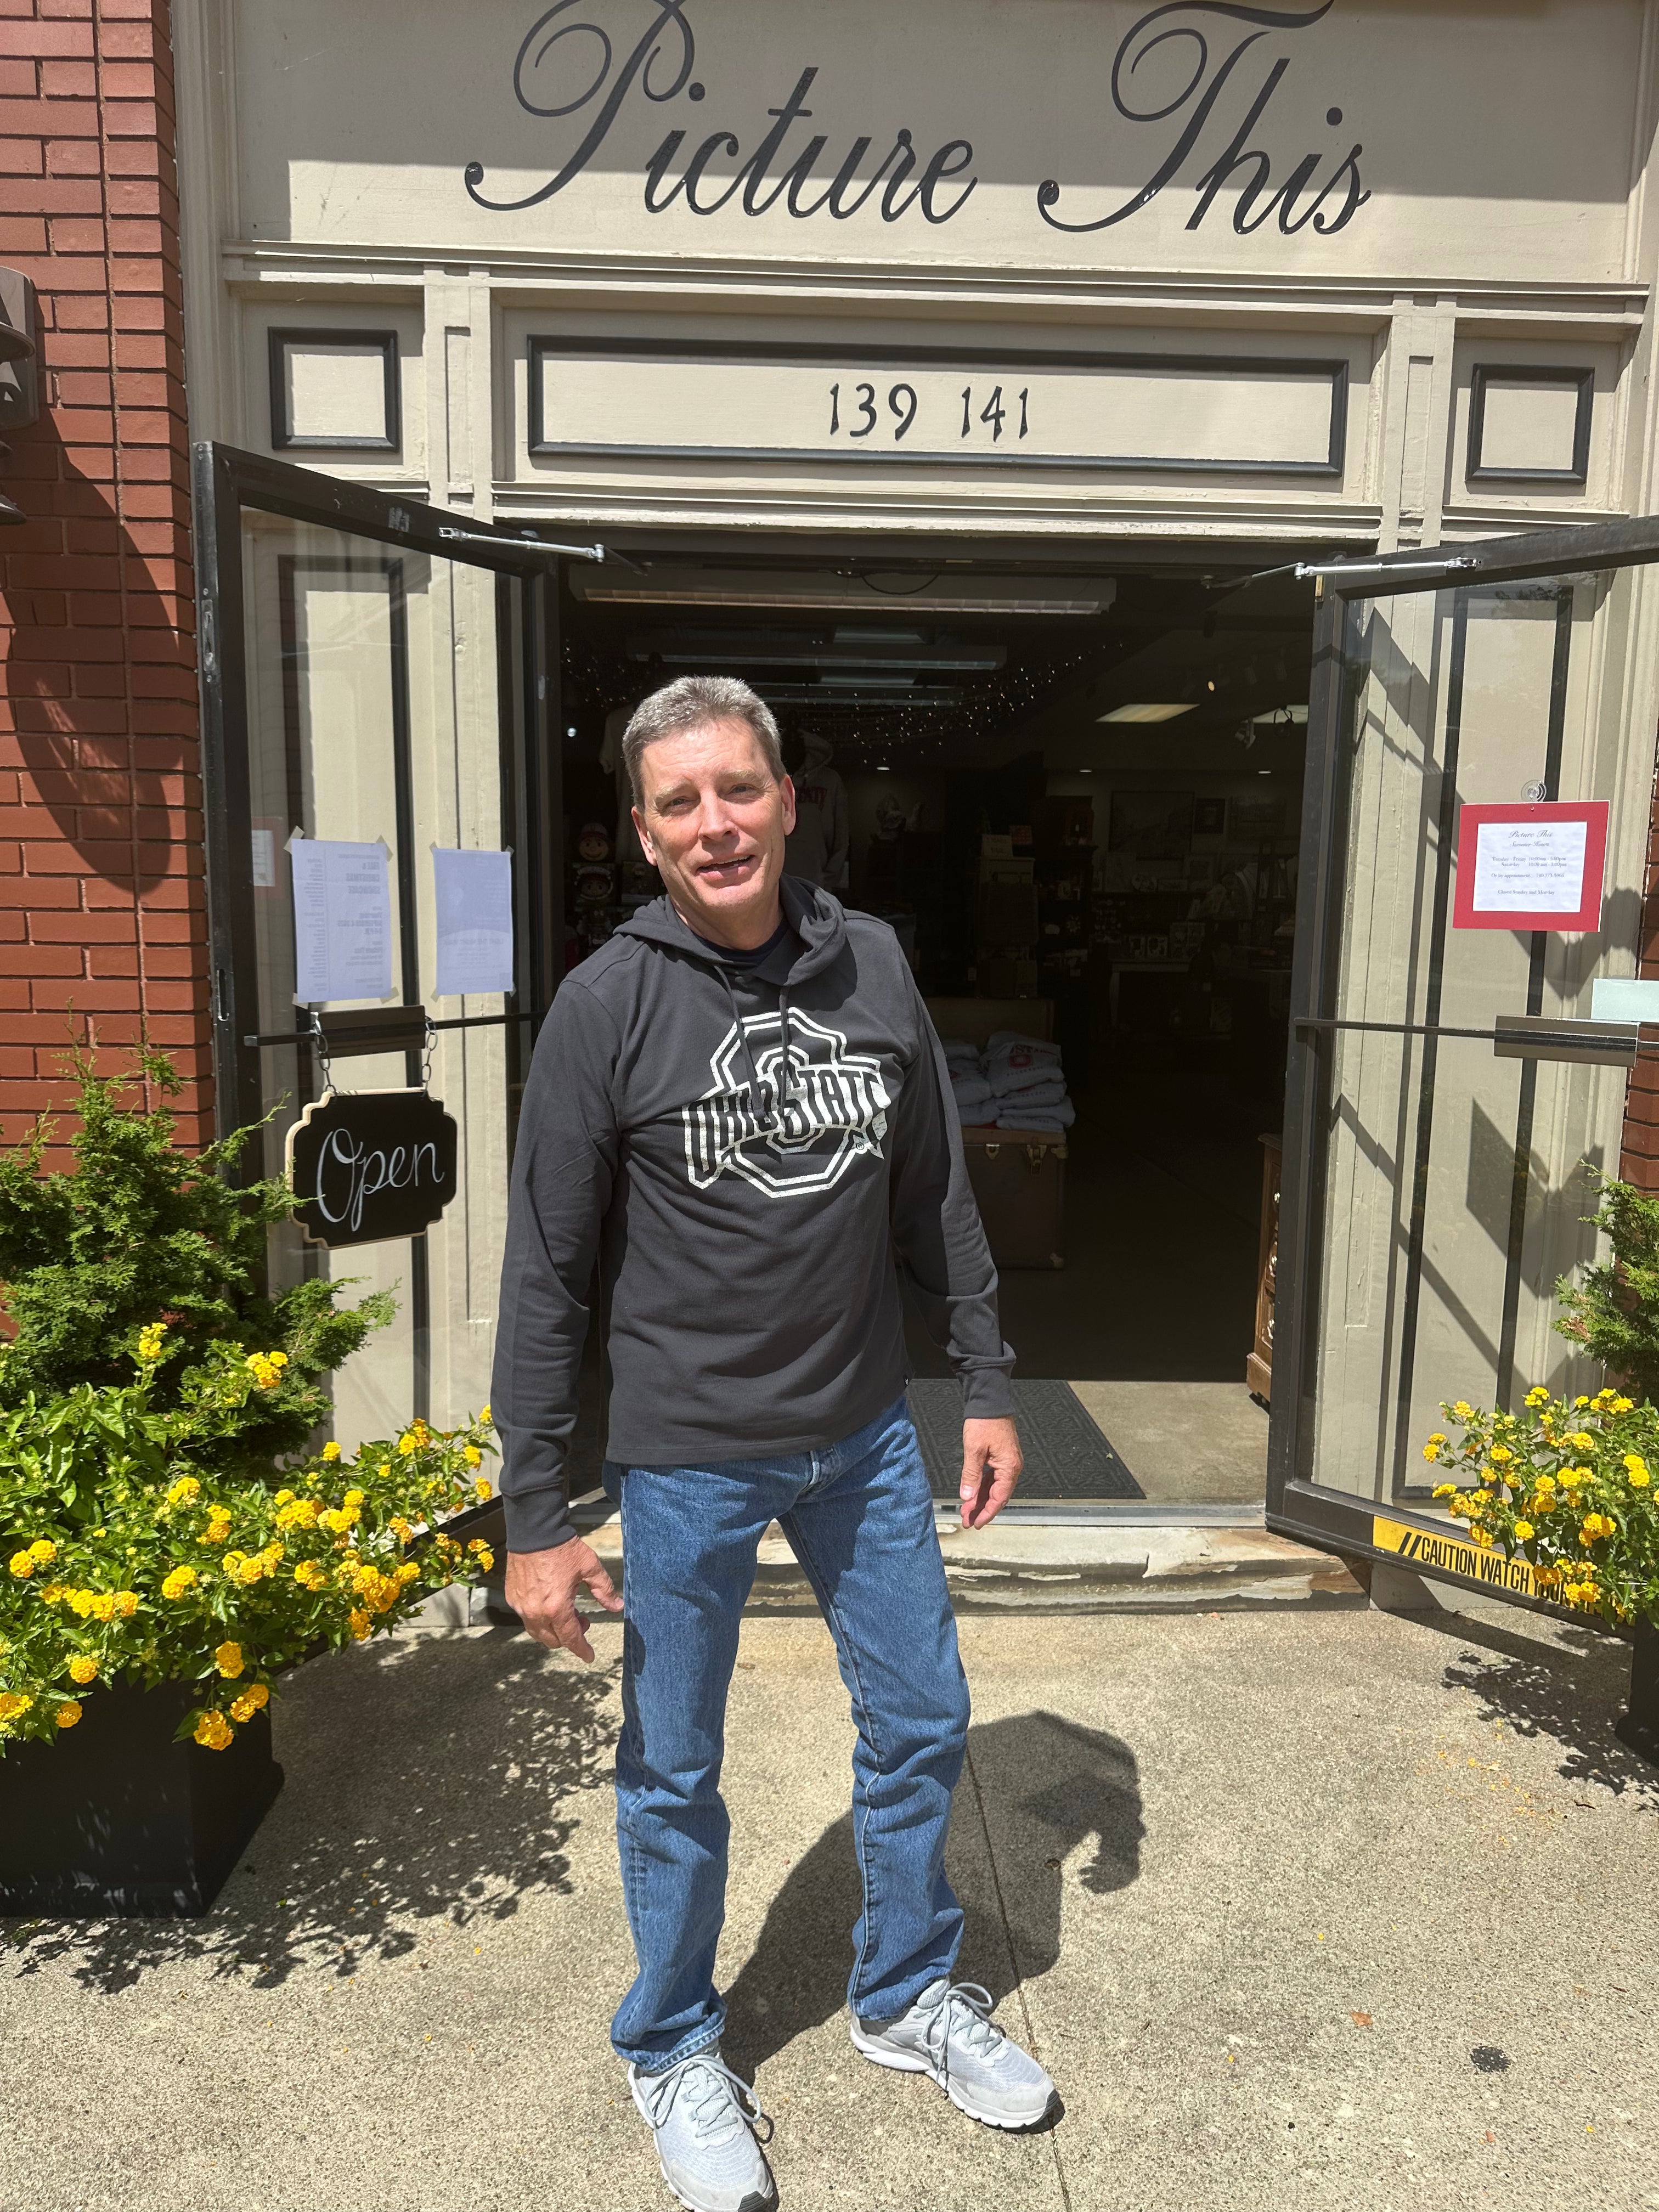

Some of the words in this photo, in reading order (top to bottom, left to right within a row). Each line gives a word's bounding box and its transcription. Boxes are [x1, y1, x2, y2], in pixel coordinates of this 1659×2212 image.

[464, 0, 978, 225] Picture
[1038, 0, 1373, 236] This
[830, 383, 917, 441] 139
[961, 386, 1028, 442] 141
[316, 1127, 445, 1232] Open
[1420, 1537, 1477, 1577] CAUTION
[1480, 1555, 1531, 1593] WATCH
